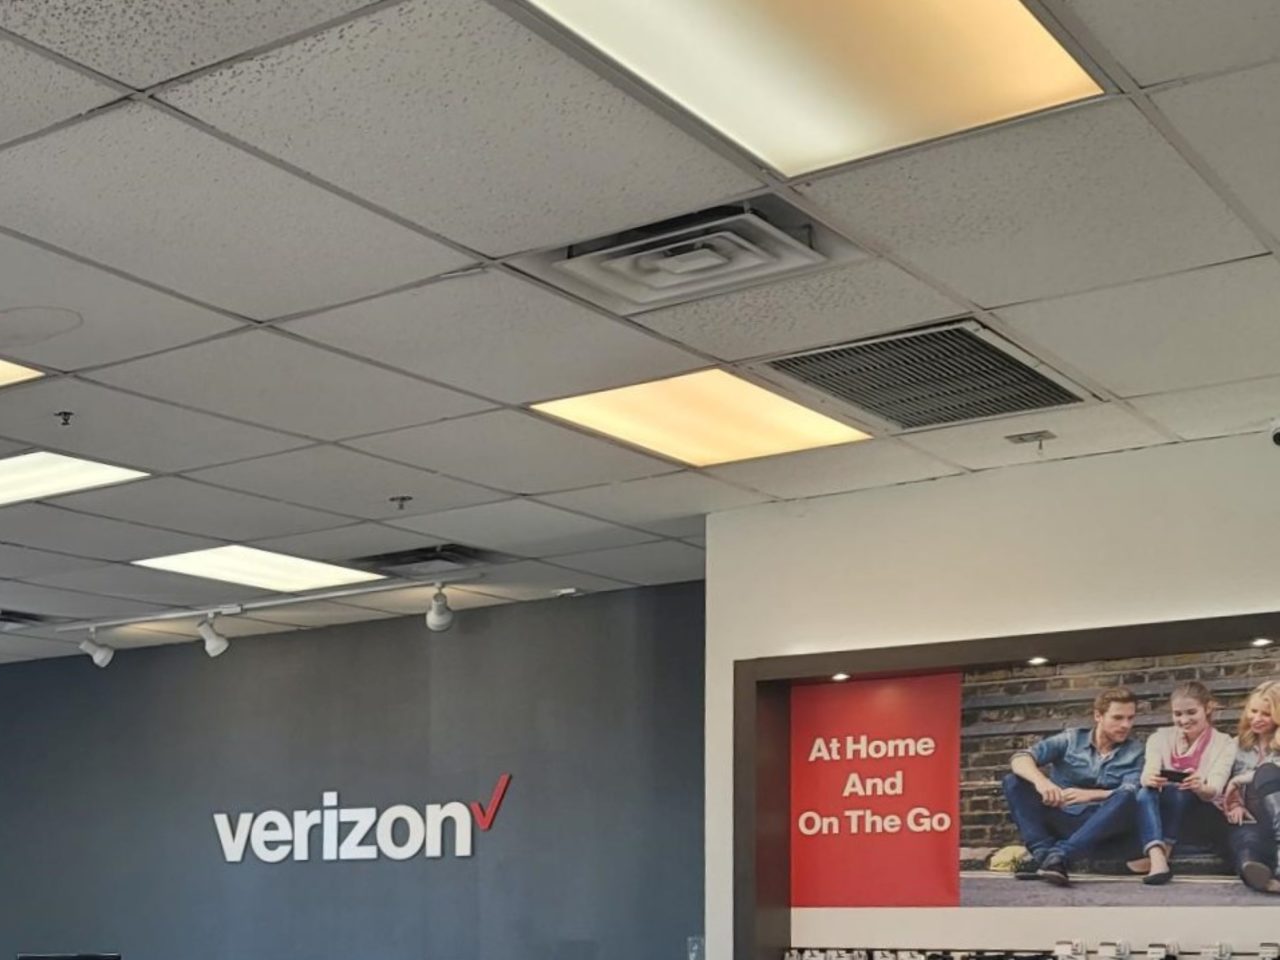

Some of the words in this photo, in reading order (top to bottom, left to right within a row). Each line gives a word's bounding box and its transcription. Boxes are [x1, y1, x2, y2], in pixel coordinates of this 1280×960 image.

[808, 737, 841, 762] At
[845, 735, 936, 760] Home
[842, 770, 903, 797] And
[213, 791, 472, 863] verizon
[798, 811, 839, 836] On
[844, 808, 902, 834] The
[906, 807, 952, 833] Go
